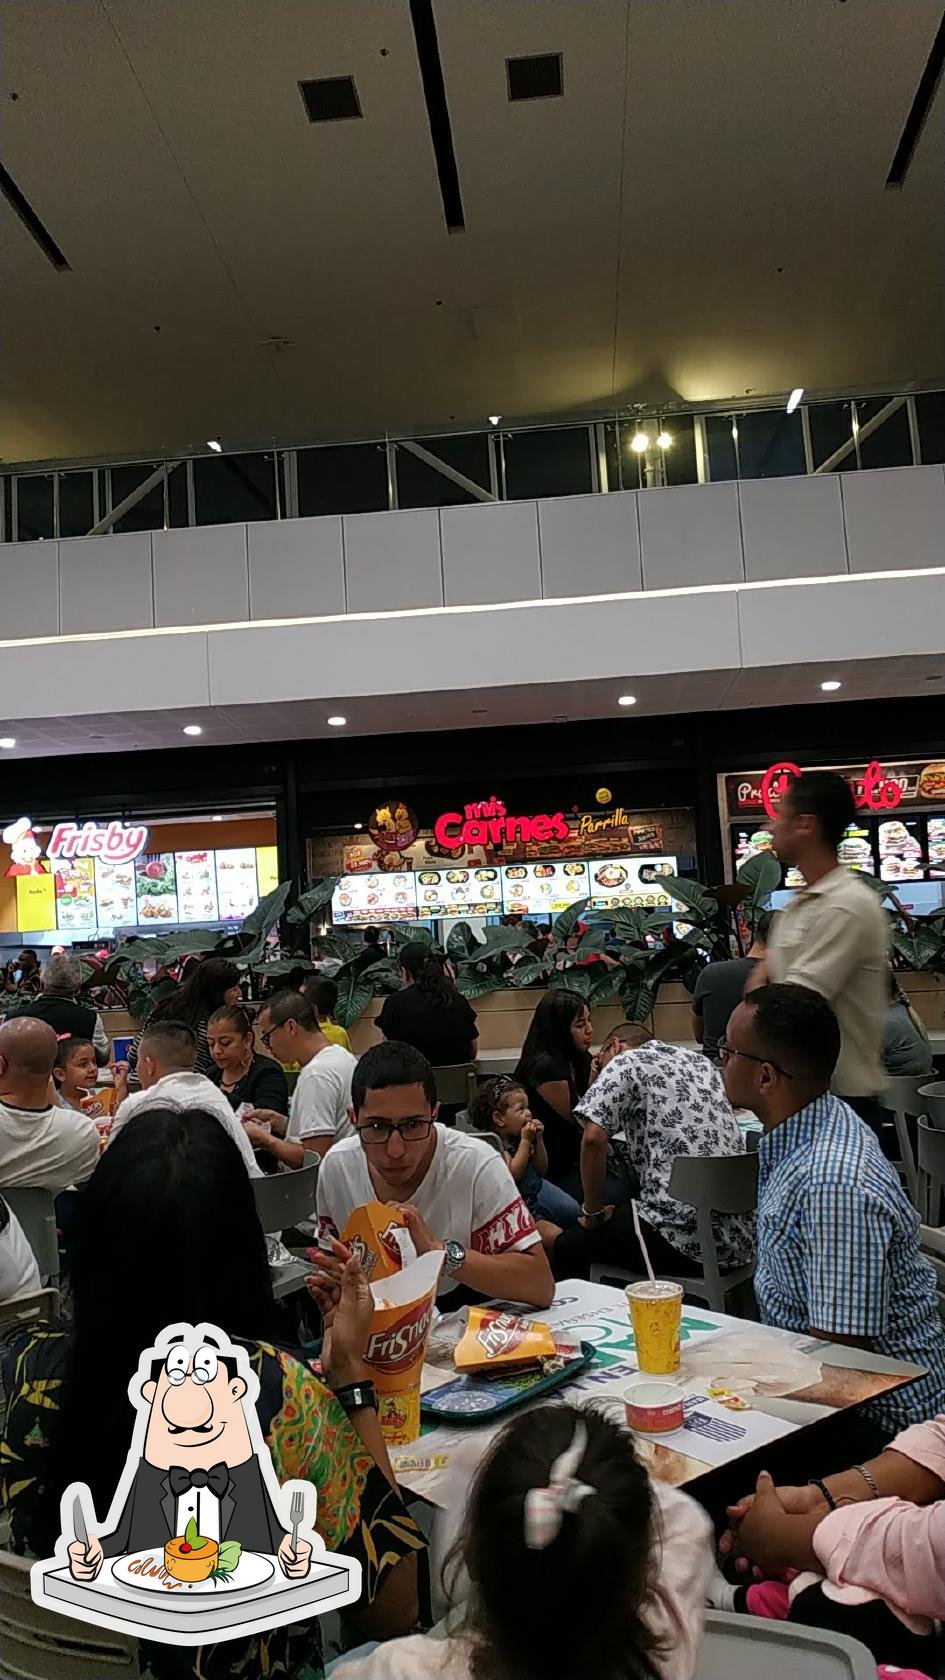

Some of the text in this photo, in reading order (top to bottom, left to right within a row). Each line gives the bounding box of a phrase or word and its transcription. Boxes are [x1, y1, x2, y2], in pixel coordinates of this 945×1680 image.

[433, 811, 570, 850] Carnes
[578, 807, 631, 836] Parrilla
[49, 823, 146, 862] Frisby
